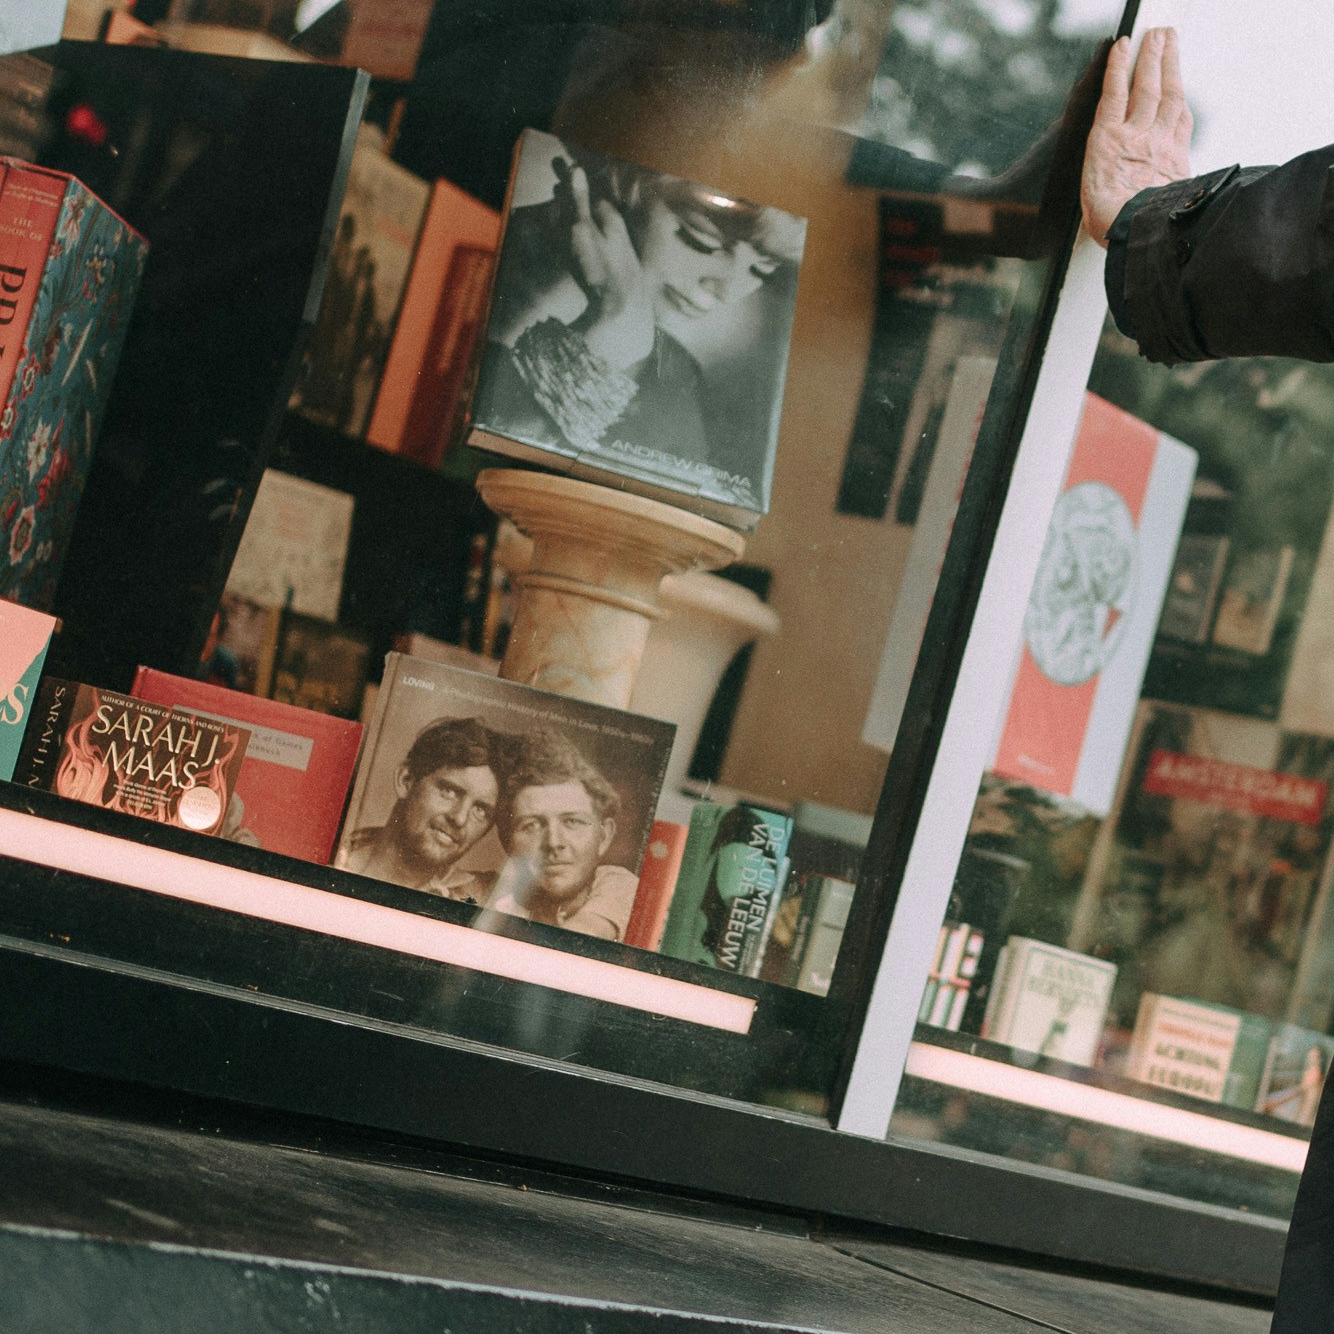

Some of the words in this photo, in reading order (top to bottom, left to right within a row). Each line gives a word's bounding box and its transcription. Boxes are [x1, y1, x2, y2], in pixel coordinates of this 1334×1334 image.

[611, 439, 693, 470] ANDREW
[101, 695, 125, 706] AUTHOR
[402, 676, 435, 691] LOVING
[42, 685, 66, 754] SARAH
[91, 704, 202, 758] SARAH
[200, 734, 221, 768] J.
[102, 740, 199, 790] MAAS
[743, 823, 770, 861] VAN
[765, 825, 786, 851] DE
[738, 866, 759, 894] DE
[746, 857, 778, 932] LUIMEN
[719, 896, 751, 968] LEEUW
